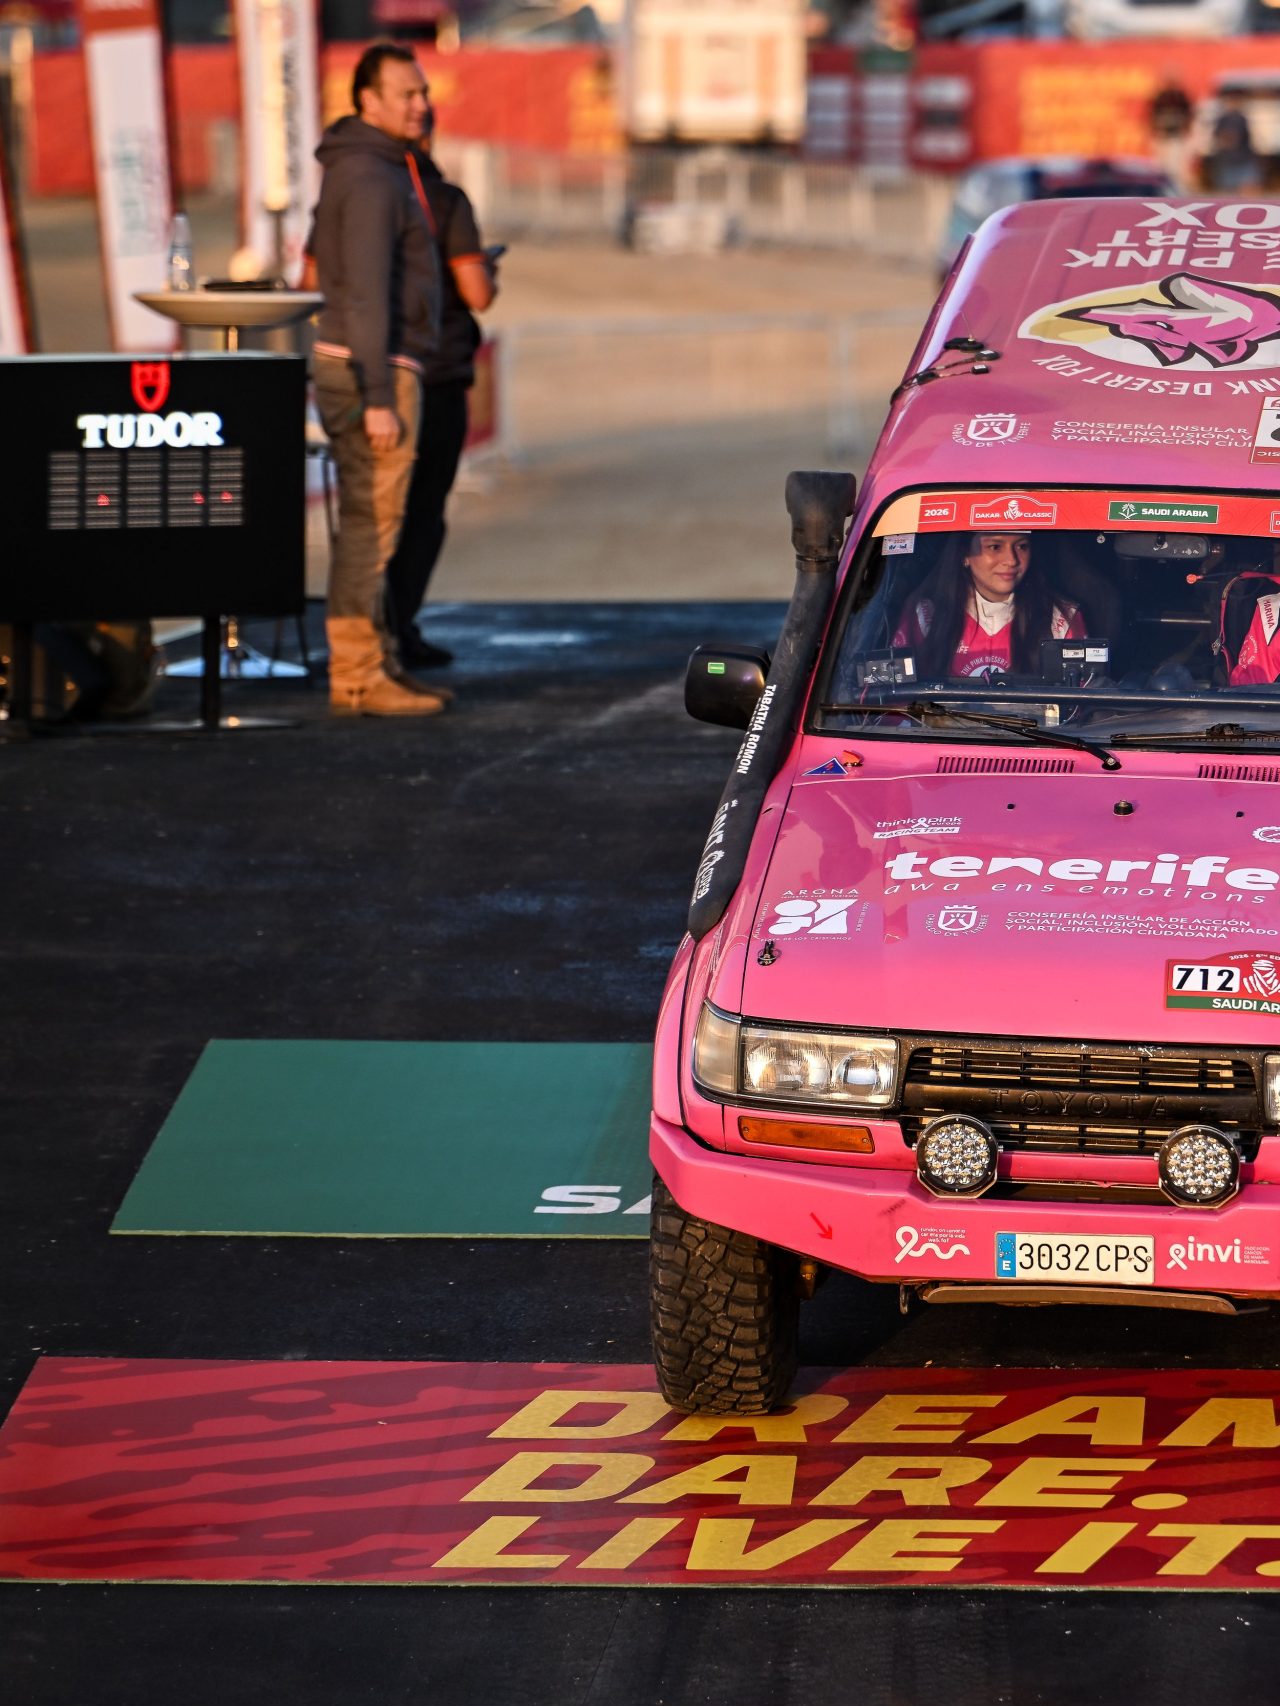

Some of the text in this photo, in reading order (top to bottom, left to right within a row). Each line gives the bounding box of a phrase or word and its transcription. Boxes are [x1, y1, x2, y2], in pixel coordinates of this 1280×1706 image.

[1062, 248, 1235, 268] PINK
[1032, 354, 1090, 374] FOX
[1086, 370, 1212, 395] DESERT
[76, 411, 224, 448] TUDOR
[1053, 427, 1123, 437] SOCIAL,
[1054, 420, 1248, 435] CONSEJERÍA INSULAR
[1066, 435, 1210, 446] PARTICIPACIÓN
[924, 508, 949, 517] 2026
[1141, 507, 1208, 518] SAUDI ARABIA
[960, 664, 972, 675] THE
[970, 657, 984, 667] PINK
[736, 684, 776, 775] TABATHA ROMON
[876, 816, 963, 828] think pink
[1079, 884, 1266, 904] emotions
[1006, 918, 1062, 927] SOCIAL,
[1158, 924, 1278, 936] VOLUNTARIADO
[1008, 911, 1096, 921] CONSEJERÍA
[1101, 914, 1164, 923] INSULAR
[1191, 917, 1250, 926] ACCIÓN
[1017, 925, 1133, 936] PARTICIPACIÓN
[1147, 929, 1227, 939] CIUDADANA
[1176, 968, 1235, 991] 712
[1212, 998, 1257, 1011] SAUDI
[989, 1089, 1170, 1120] TOYOTA
[1019, 1243, 1150, 1275] 3032 CPS
[1188, 1236, 1241, 1263] invi
[1002, 1260, 1011, 1271] E
[461, 1451, 1189, 1510] DARE.
[431, 1515, 1005, 1572] LIVE
